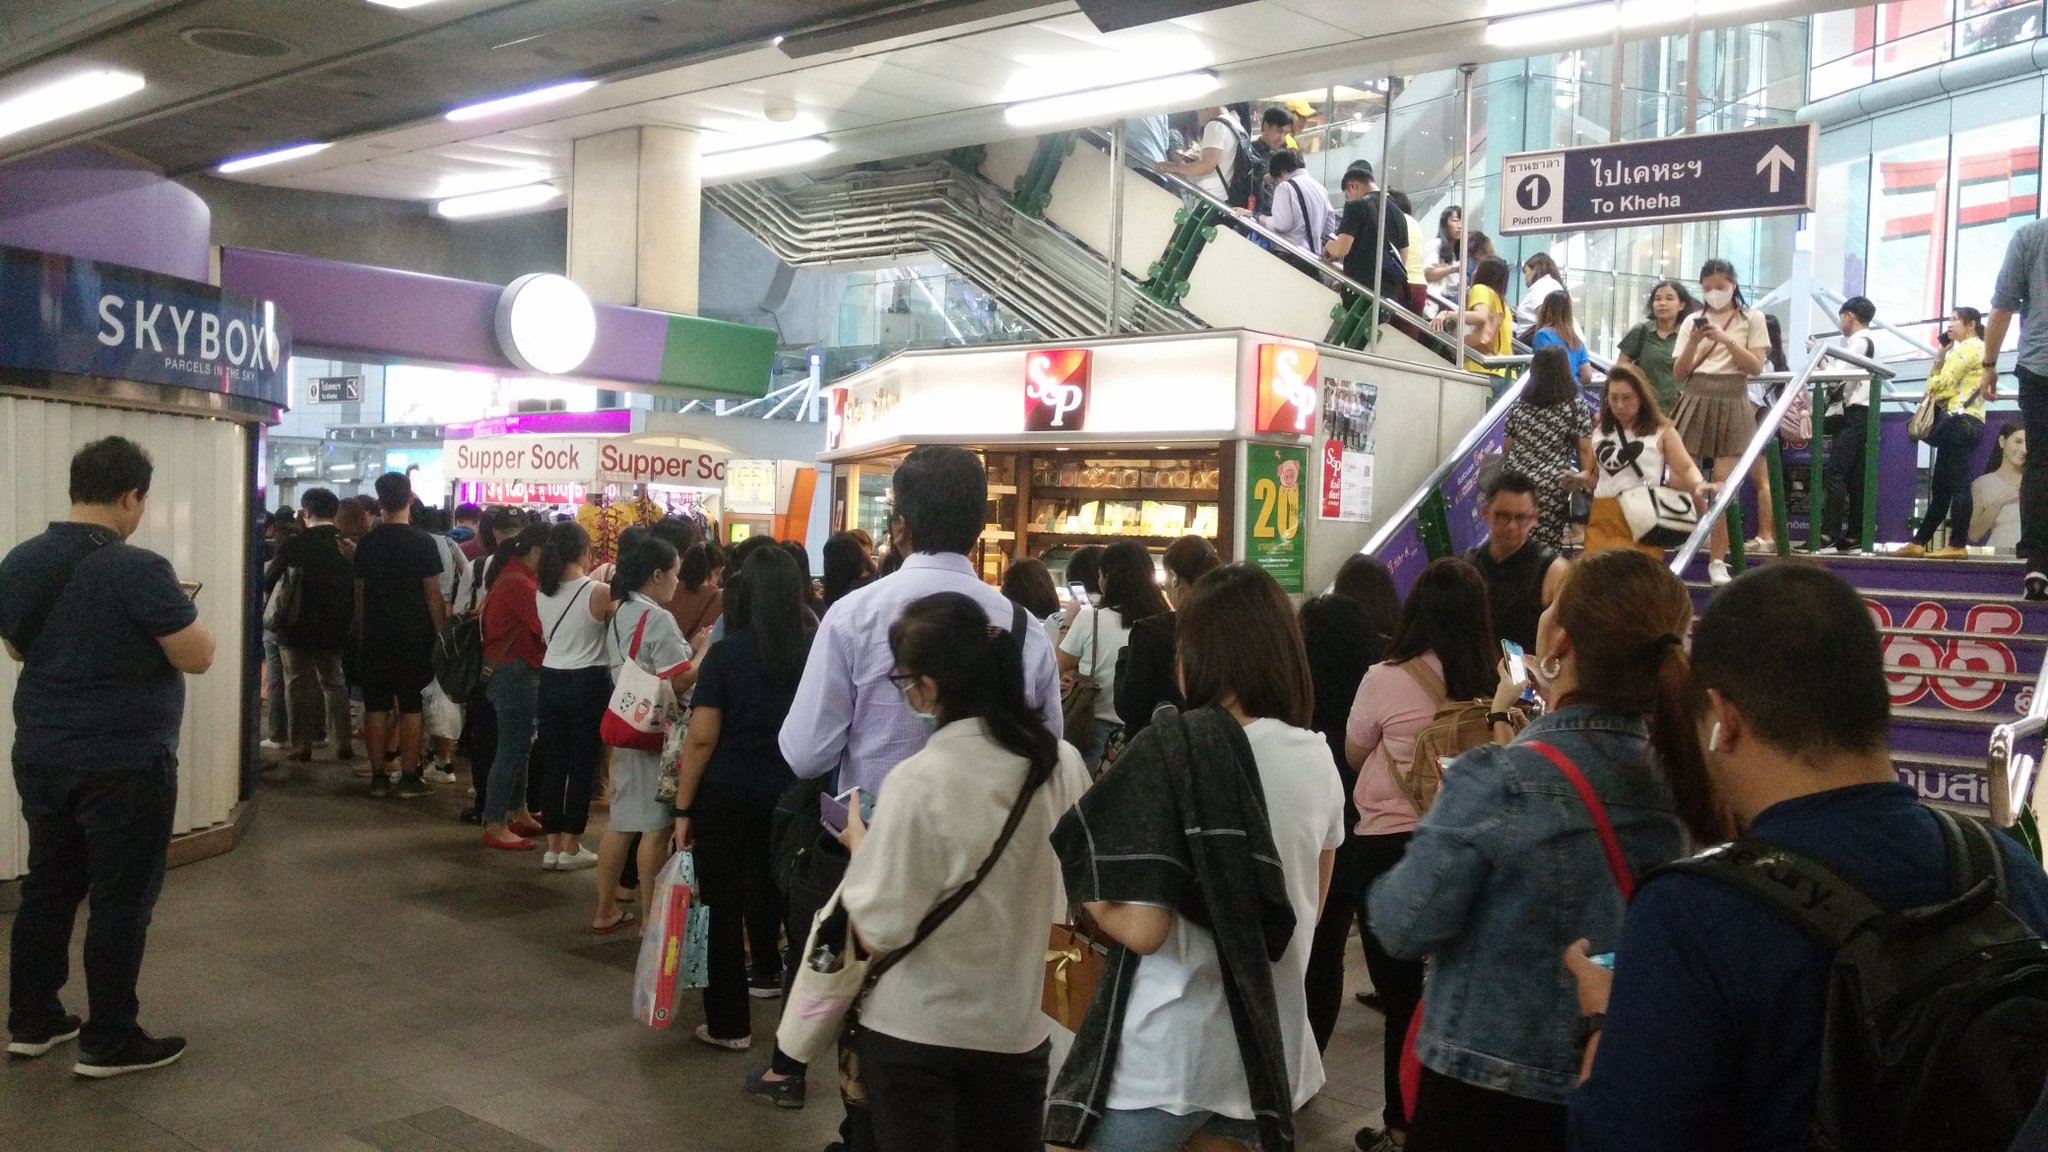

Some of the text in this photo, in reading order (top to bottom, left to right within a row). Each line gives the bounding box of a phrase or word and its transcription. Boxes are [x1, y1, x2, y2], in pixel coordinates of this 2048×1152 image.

[1508, 158, 1561, 174] ชานชาลา
[1590, 157, 1703, 188] ไปเคหะฯ
[1525, 177, 1540, 207] 1
[1591, 193, 1681, 214] To Kheha
[1512, 214, 1553, 226] Platform
[97, 294, 266, 371] SKYBOX
[164, 357, 256, 382] PARCELS IN THE SKY
[1026, 355, 1083, 427] S&P
[457, 443, 580, 475] Supper Sock
[600, 444, 693, 482] Supper
[1253, 477, 1299, 540] 20
